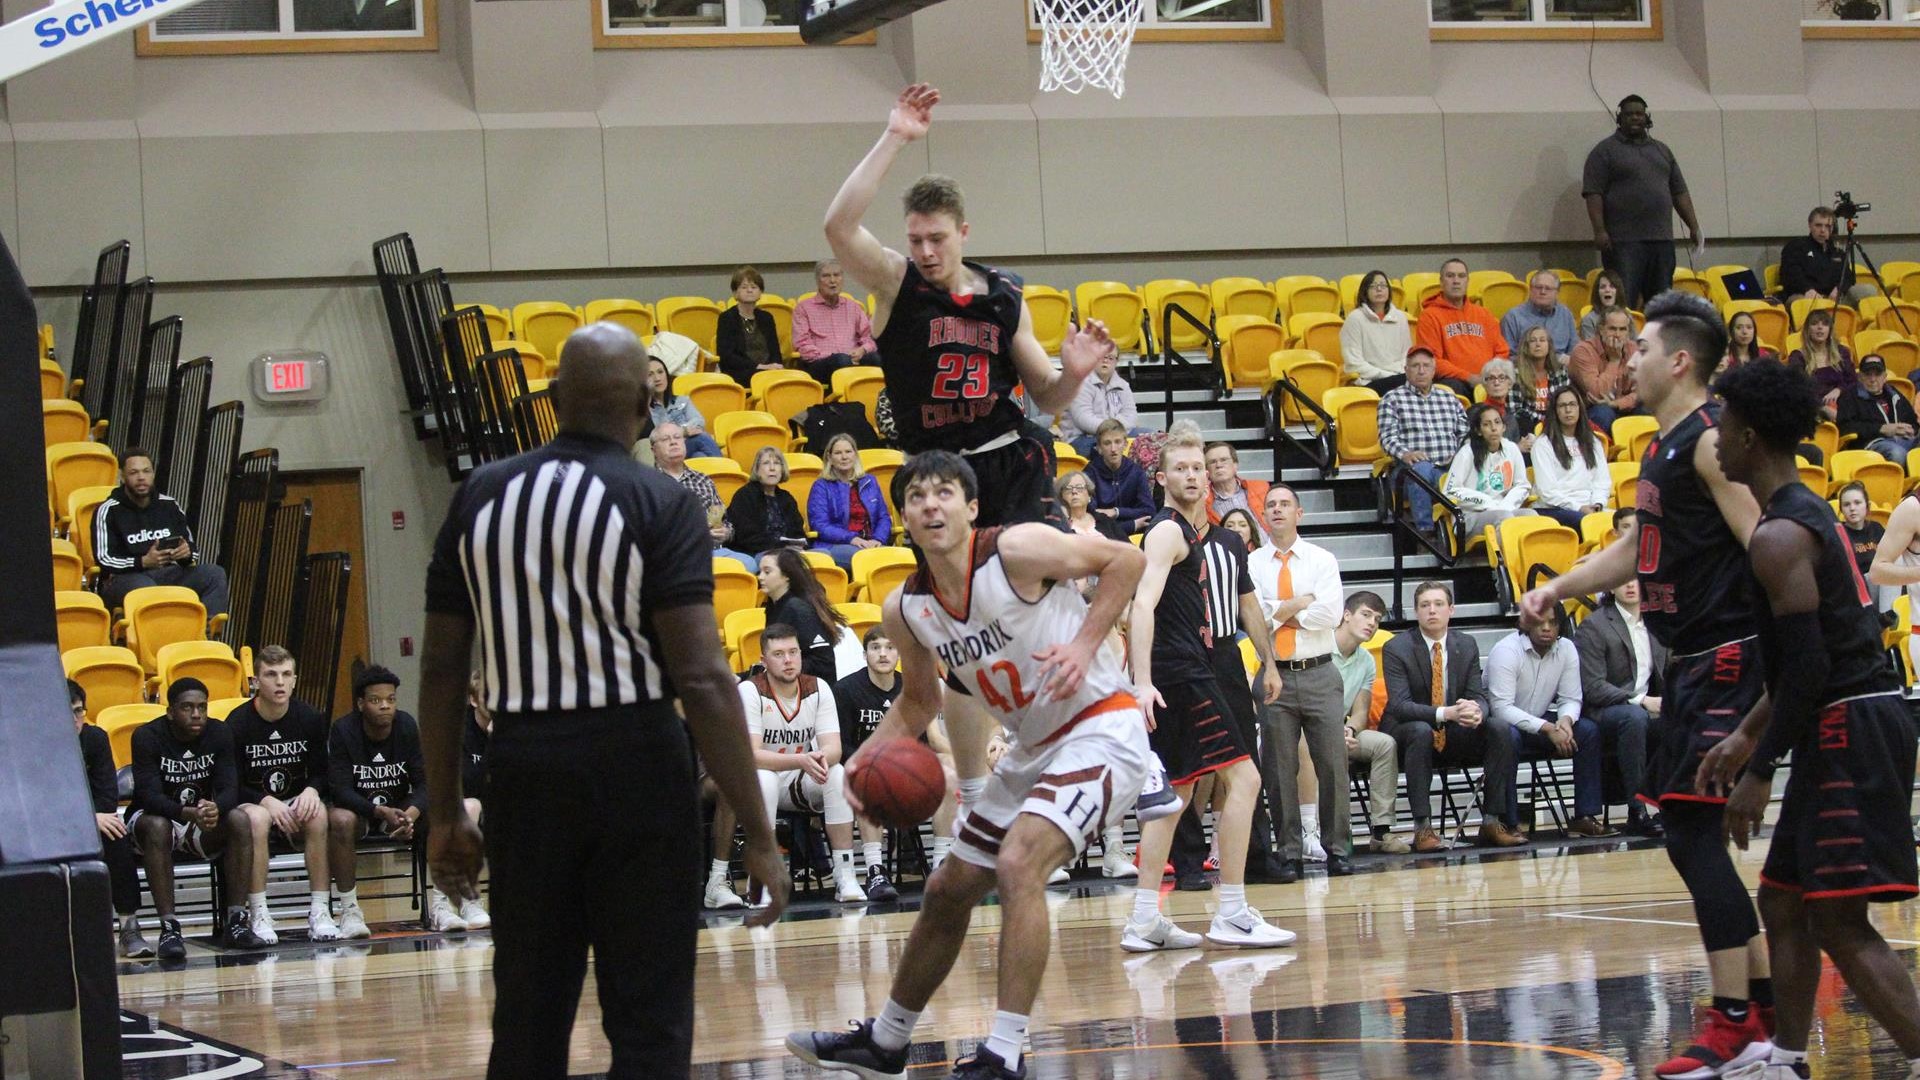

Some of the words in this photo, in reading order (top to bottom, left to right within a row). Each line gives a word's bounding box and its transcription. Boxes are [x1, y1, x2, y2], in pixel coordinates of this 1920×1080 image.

[34, 0, 169, 48] Sche
[928, 316, 1000, 354] RHODES
[272, 361, 305, 390] EXIT
[931, 353, 989, 399] 23
[1713, 643, 1742, 682] LYN
[976, 660, 1036, 713] 42
[763, 727, 816, 744] HENDRIX
[1819, 703, 1848, 749] LYN
[245, 740, 309, 759] HENDRIX
[250, 755, 301, 768] BASKETBALL
[352, 761, 408, 780] HENDRIX
[356, 778, 401, 789] BASKETBALL
[1063, 786, 1100, 831] H
